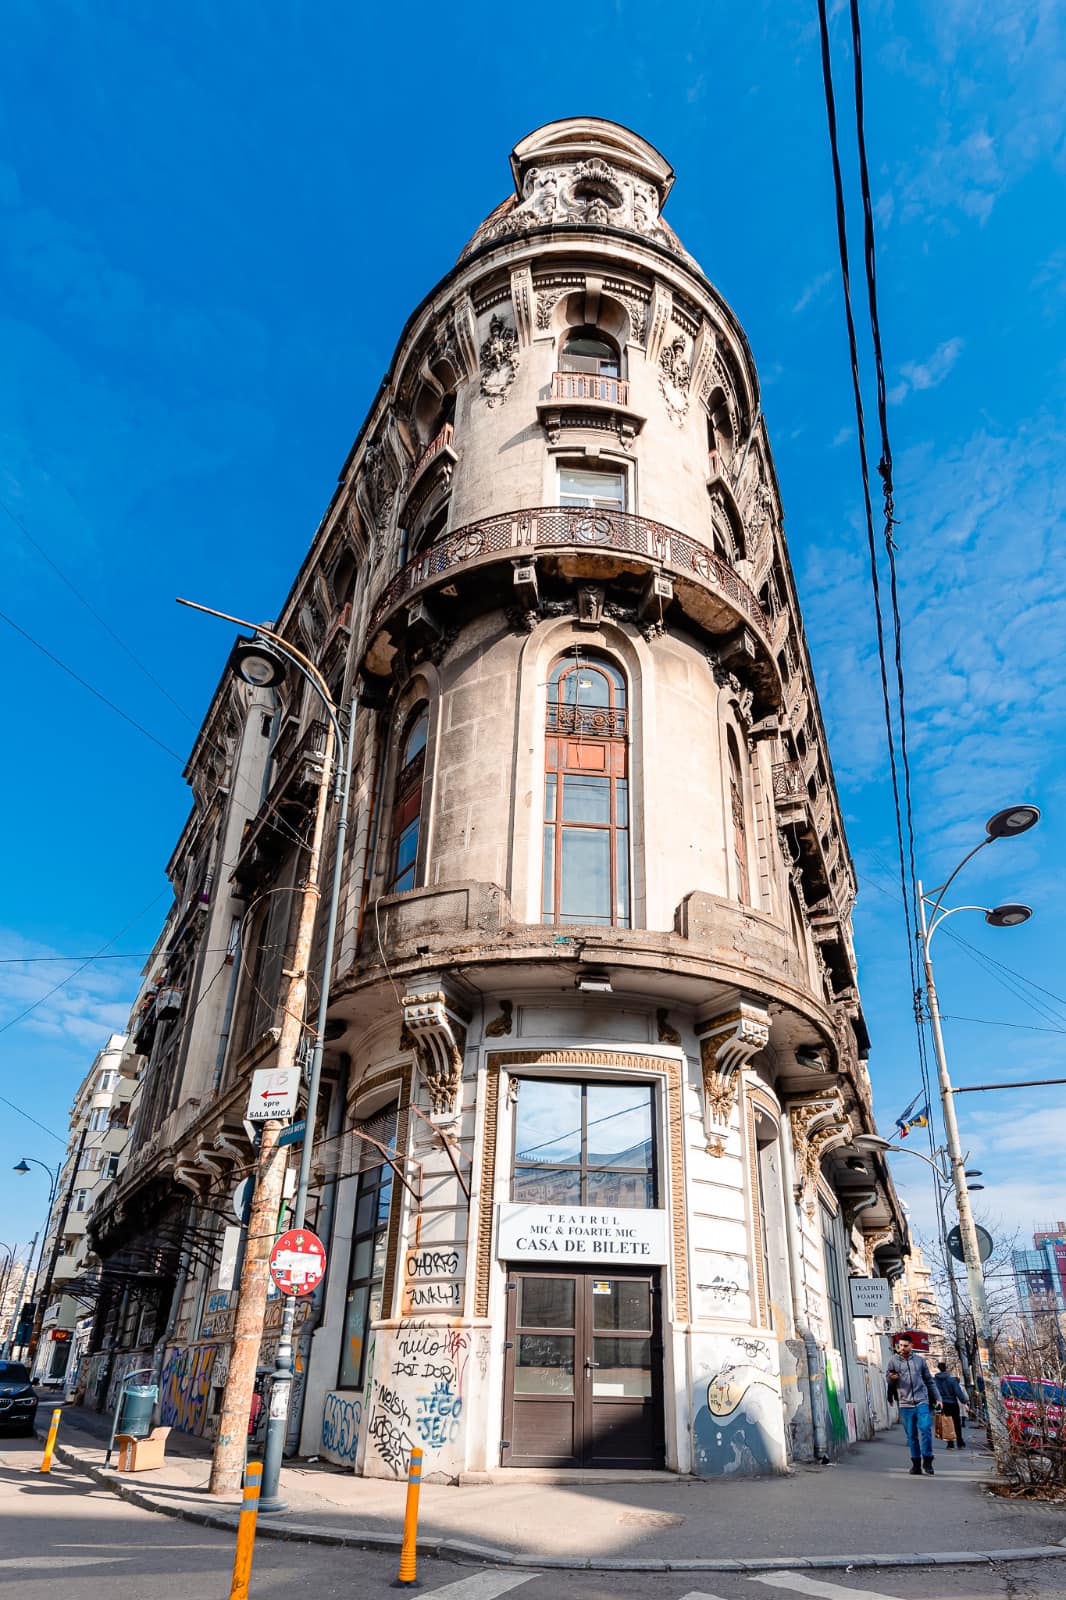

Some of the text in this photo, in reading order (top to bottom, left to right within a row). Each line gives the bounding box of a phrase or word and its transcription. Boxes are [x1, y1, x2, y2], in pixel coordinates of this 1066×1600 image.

[263, 1100, 280, 1108] spre
[547, 1214, 620, 1225] TEATRUL
[530, 1225, 637, 1238] MIC & FOARTE MIC
[516, 1237, 651, 1255] CASA DE BILETE
